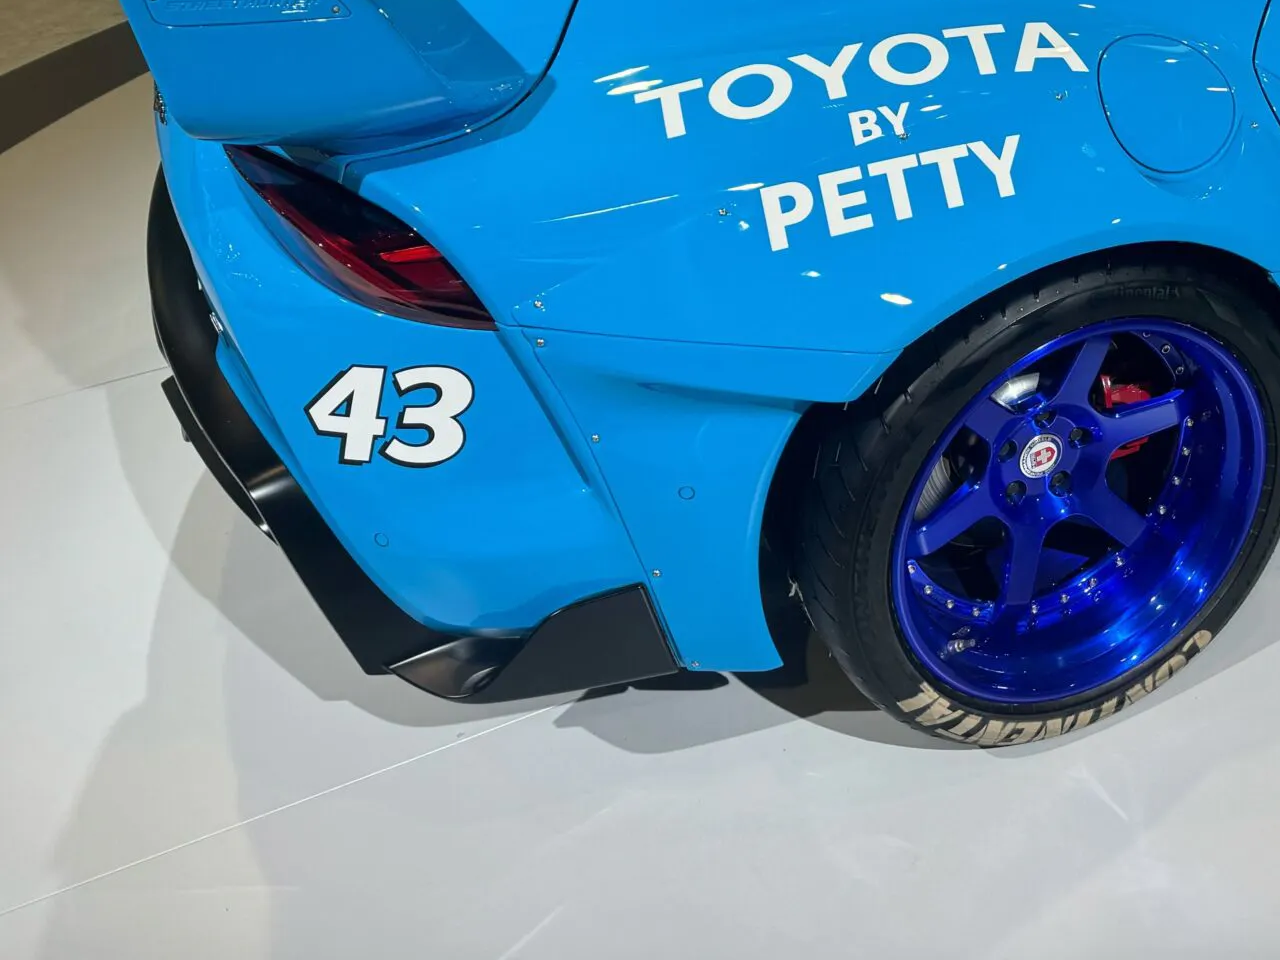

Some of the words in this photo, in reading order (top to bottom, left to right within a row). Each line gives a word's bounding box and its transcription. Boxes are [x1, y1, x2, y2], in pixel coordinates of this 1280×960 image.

[634, 21, 1091, 139] TOYOTA
[848, 101, 910, 147] BY
[759, 134, 1021, 253] PETTY
[303, 363, 475, 469] 43
[895, 629, 1213, 749] CONTINENTAL
